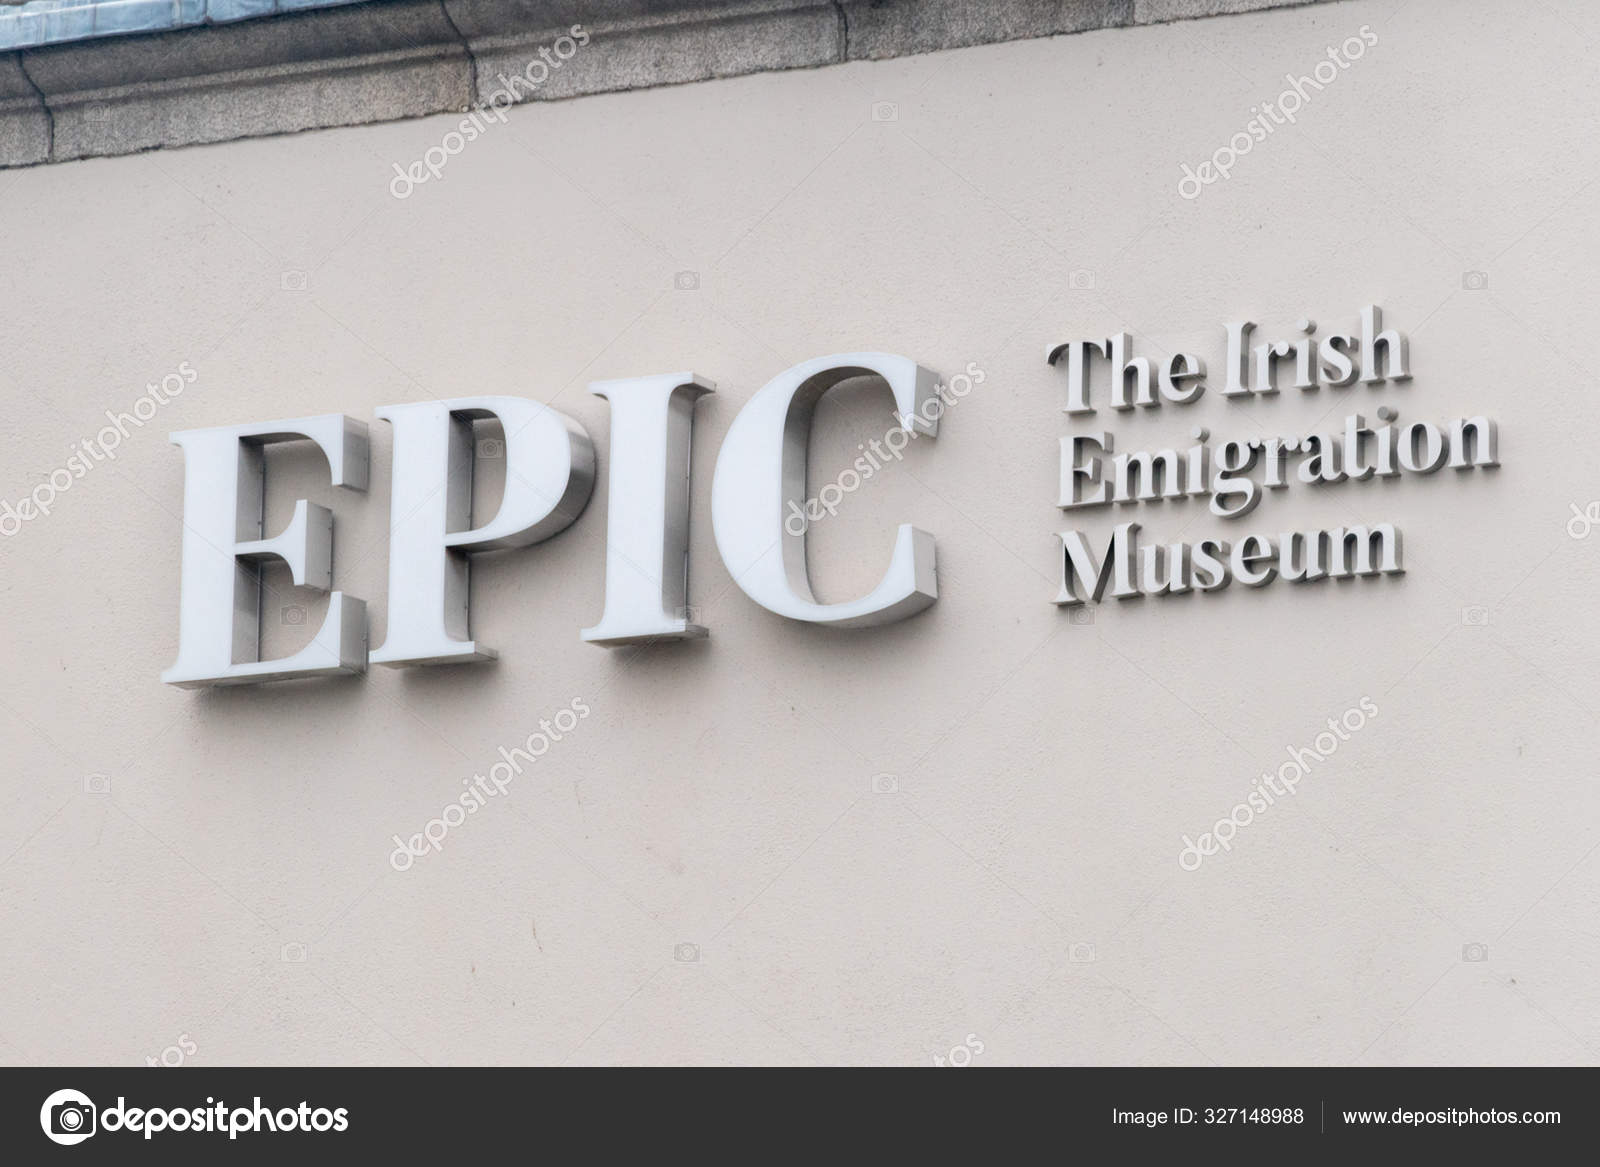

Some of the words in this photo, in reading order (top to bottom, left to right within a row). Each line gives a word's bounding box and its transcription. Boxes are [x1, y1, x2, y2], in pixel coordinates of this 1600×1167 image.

[1045, 332, 1207, 416] The
[1220, 304, 1414, 397] Irish
[1056, 406, 1502, 519] Emigration
[160, 352, 940, 689] EPIC
[1049, 521, 1407, 606] Museum
